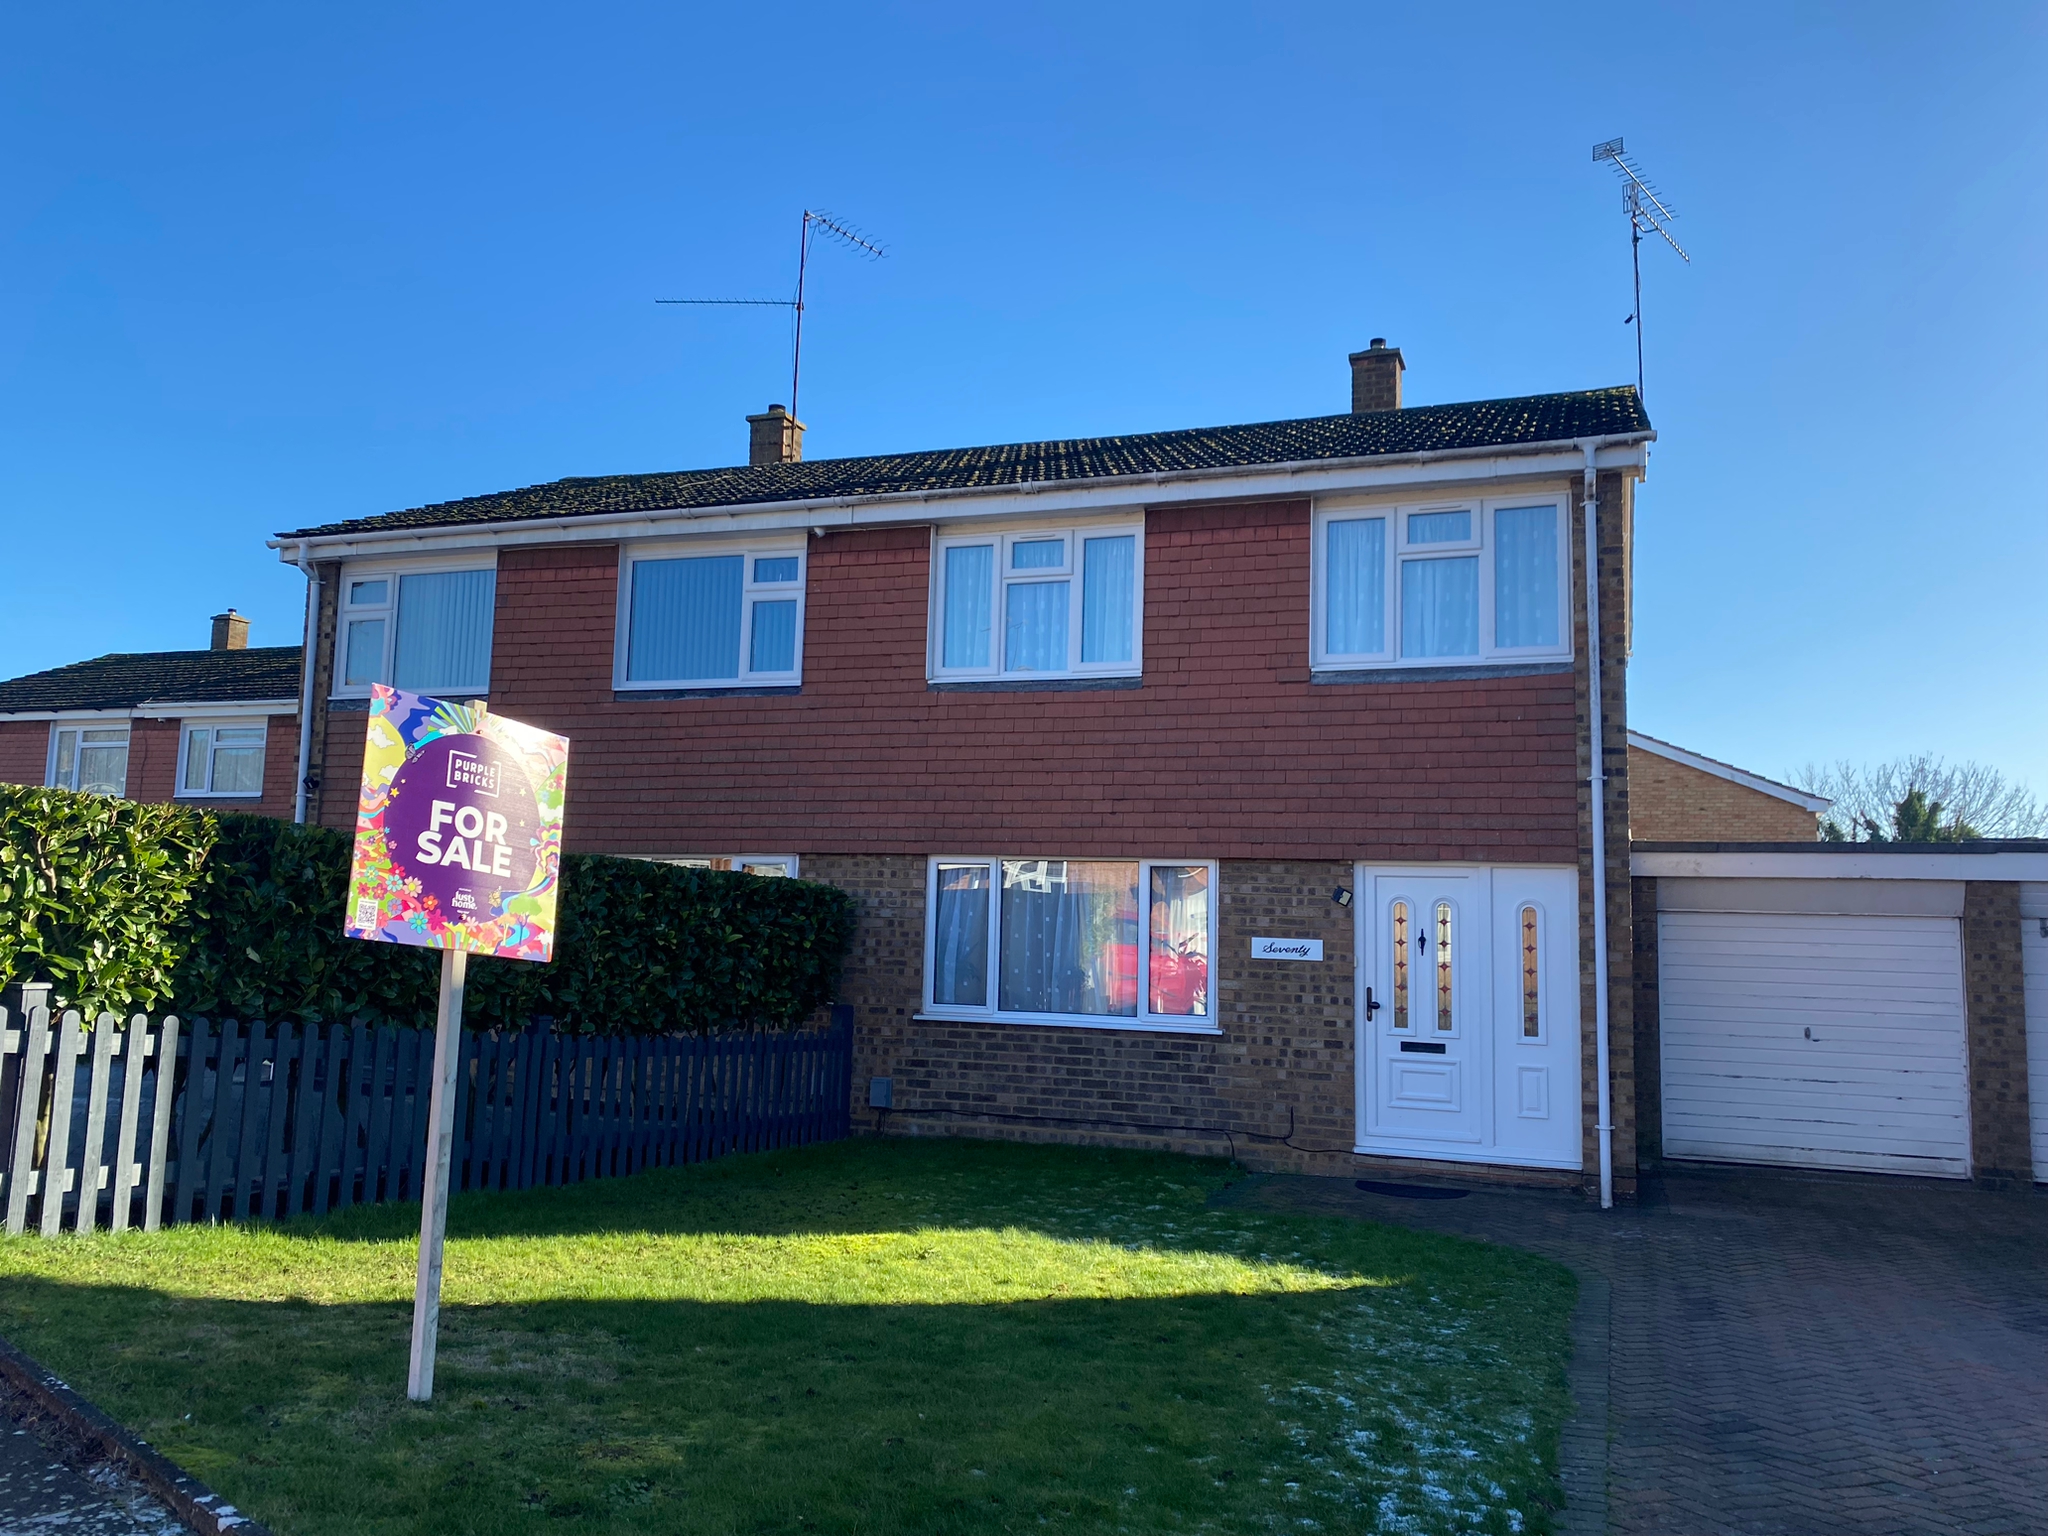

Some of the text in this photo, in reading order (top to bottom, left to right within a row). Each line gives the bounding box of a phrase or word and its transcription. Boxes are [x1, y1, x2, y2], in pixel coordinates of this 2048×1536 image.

[455, 759, 495, 777] PURPLE
[454, 770, 494, 788] BRICKS
[430, 800, 507, 845] FOR
[416, 830, 512, 877] SALE
[1262, 942, 1310, 957] Seventy
